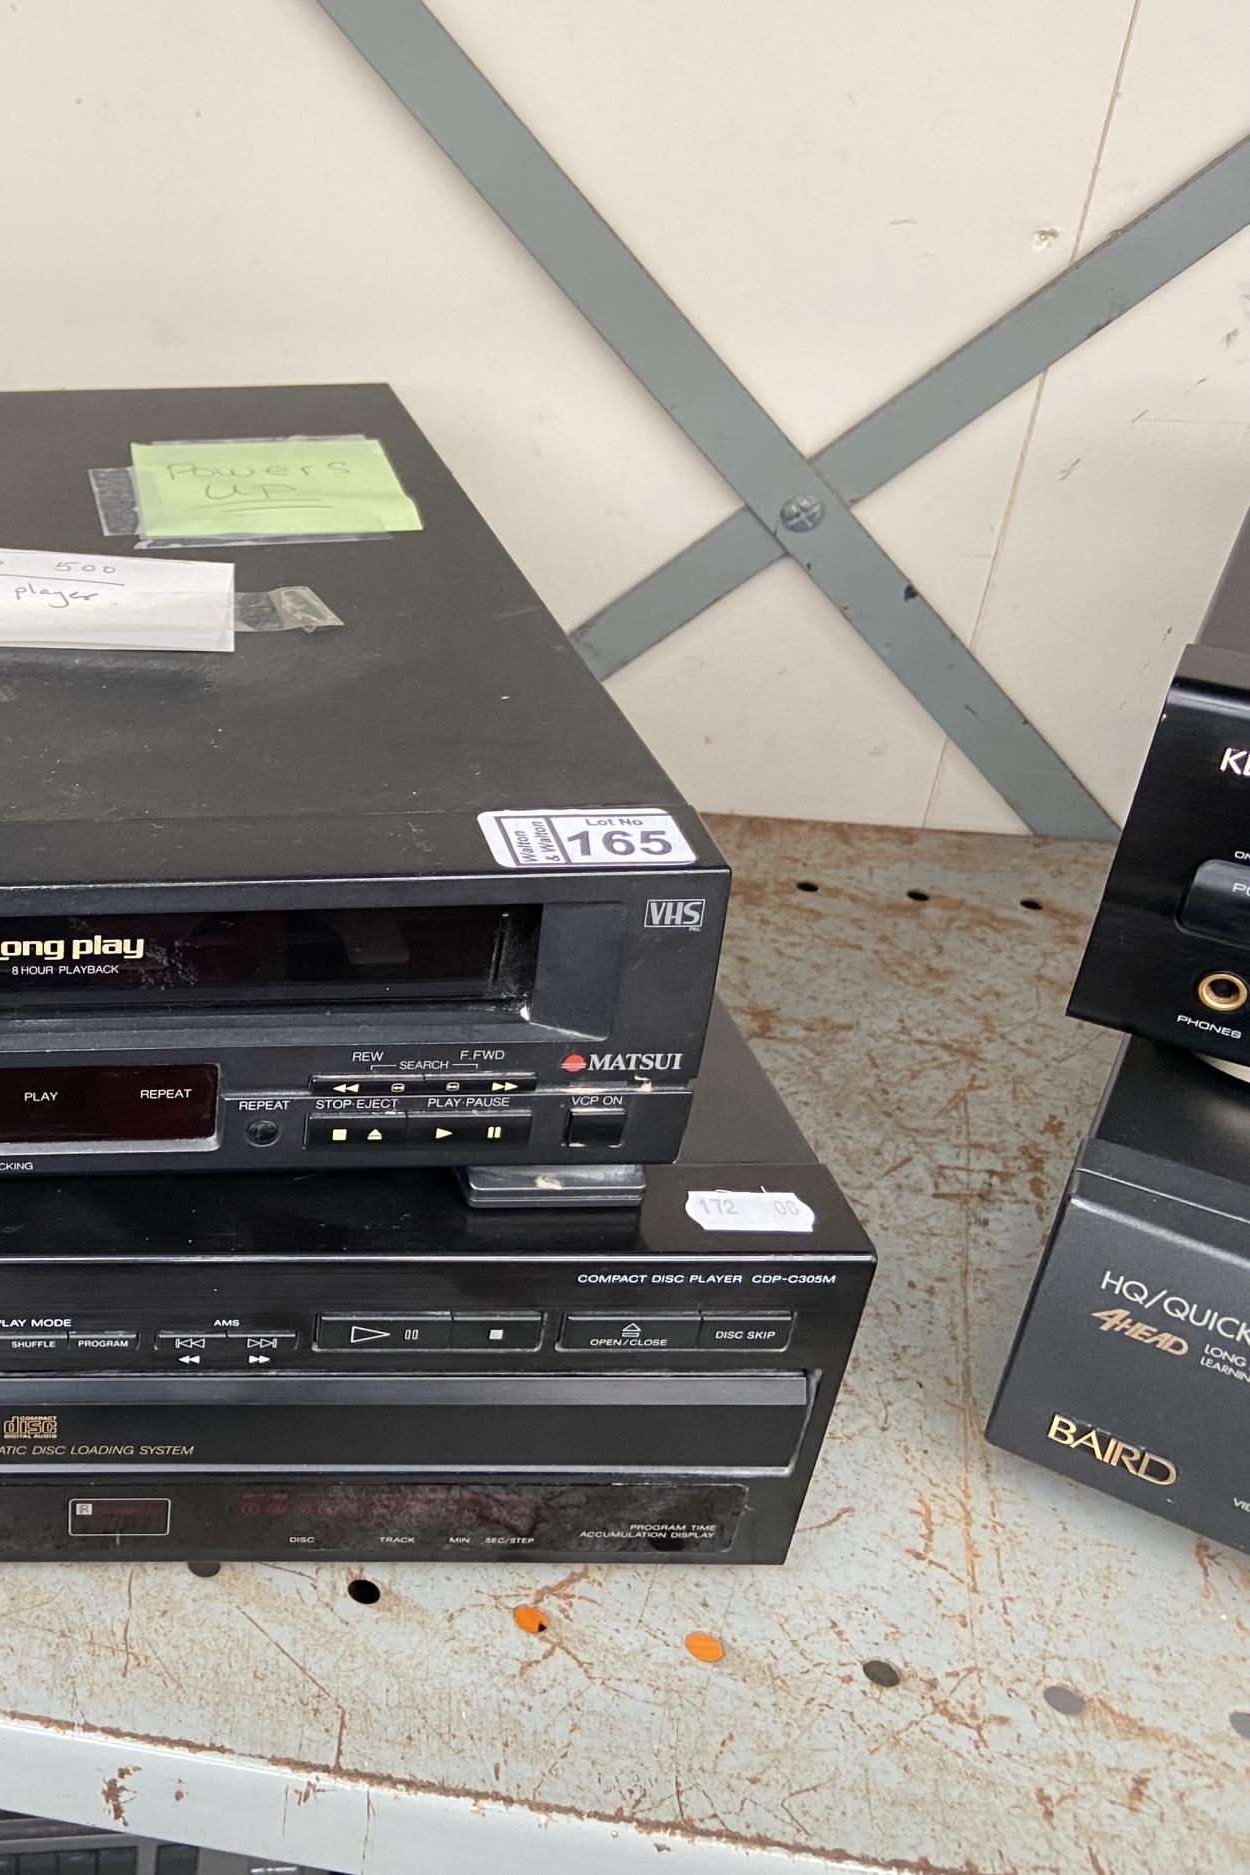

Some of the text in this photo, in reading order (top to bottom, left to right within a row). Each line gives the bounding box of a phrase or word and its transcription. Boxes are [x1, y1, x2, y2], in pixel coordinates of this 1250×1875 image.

[54, 561, 116, 574] 500
[14, 583, 99, 609] player
[585, 818, 643, 826] Lot No
[531, 821, 555, 854] Walton
[514, 831, 538, 862] Walton
[567, 830, 672, 856] 165
[650, 901, 702, 925] VHS
[72, 935, 145, 959] play
[11, 965, 119, 975] 8 HOUR PLAYBACK
[1177, 1014, 1242, 1039] PHONES
[352, 1051, 384, 1062] REW
[460, 1050, 505, 1060] F.FWD
[399, 1061, 449, 1070] SEARCH
[587, 1053, 683, 1071] MATSUI
[24, 1092, 58, 1102] PLAY
[140, 1089, 191, 1099] REPEAT
[238, 1101, 291, 1111] REPEAT
[571, 1096, 623, 1106] VCP ON
[577, 1274, 837, 1284] COMPACT DISC PLAYER CDP-C305M
[31, 1318, 72, 1327] MODE
[213, 1319, 240, 1327] AMS
[715, 1331, 776, 1340] DISC SKIP
[77, 1340, 129, 1348] PROGRAM
[1204, 1344, 1247, 1367] LONG
[32, 1446, 66, 1455] DISC
[70, 1445, 134, 1455] LOADING
[139, 1446, 195, 1455] SYSTEM
[1047, 1413, 1178, 1486] BAIRD
